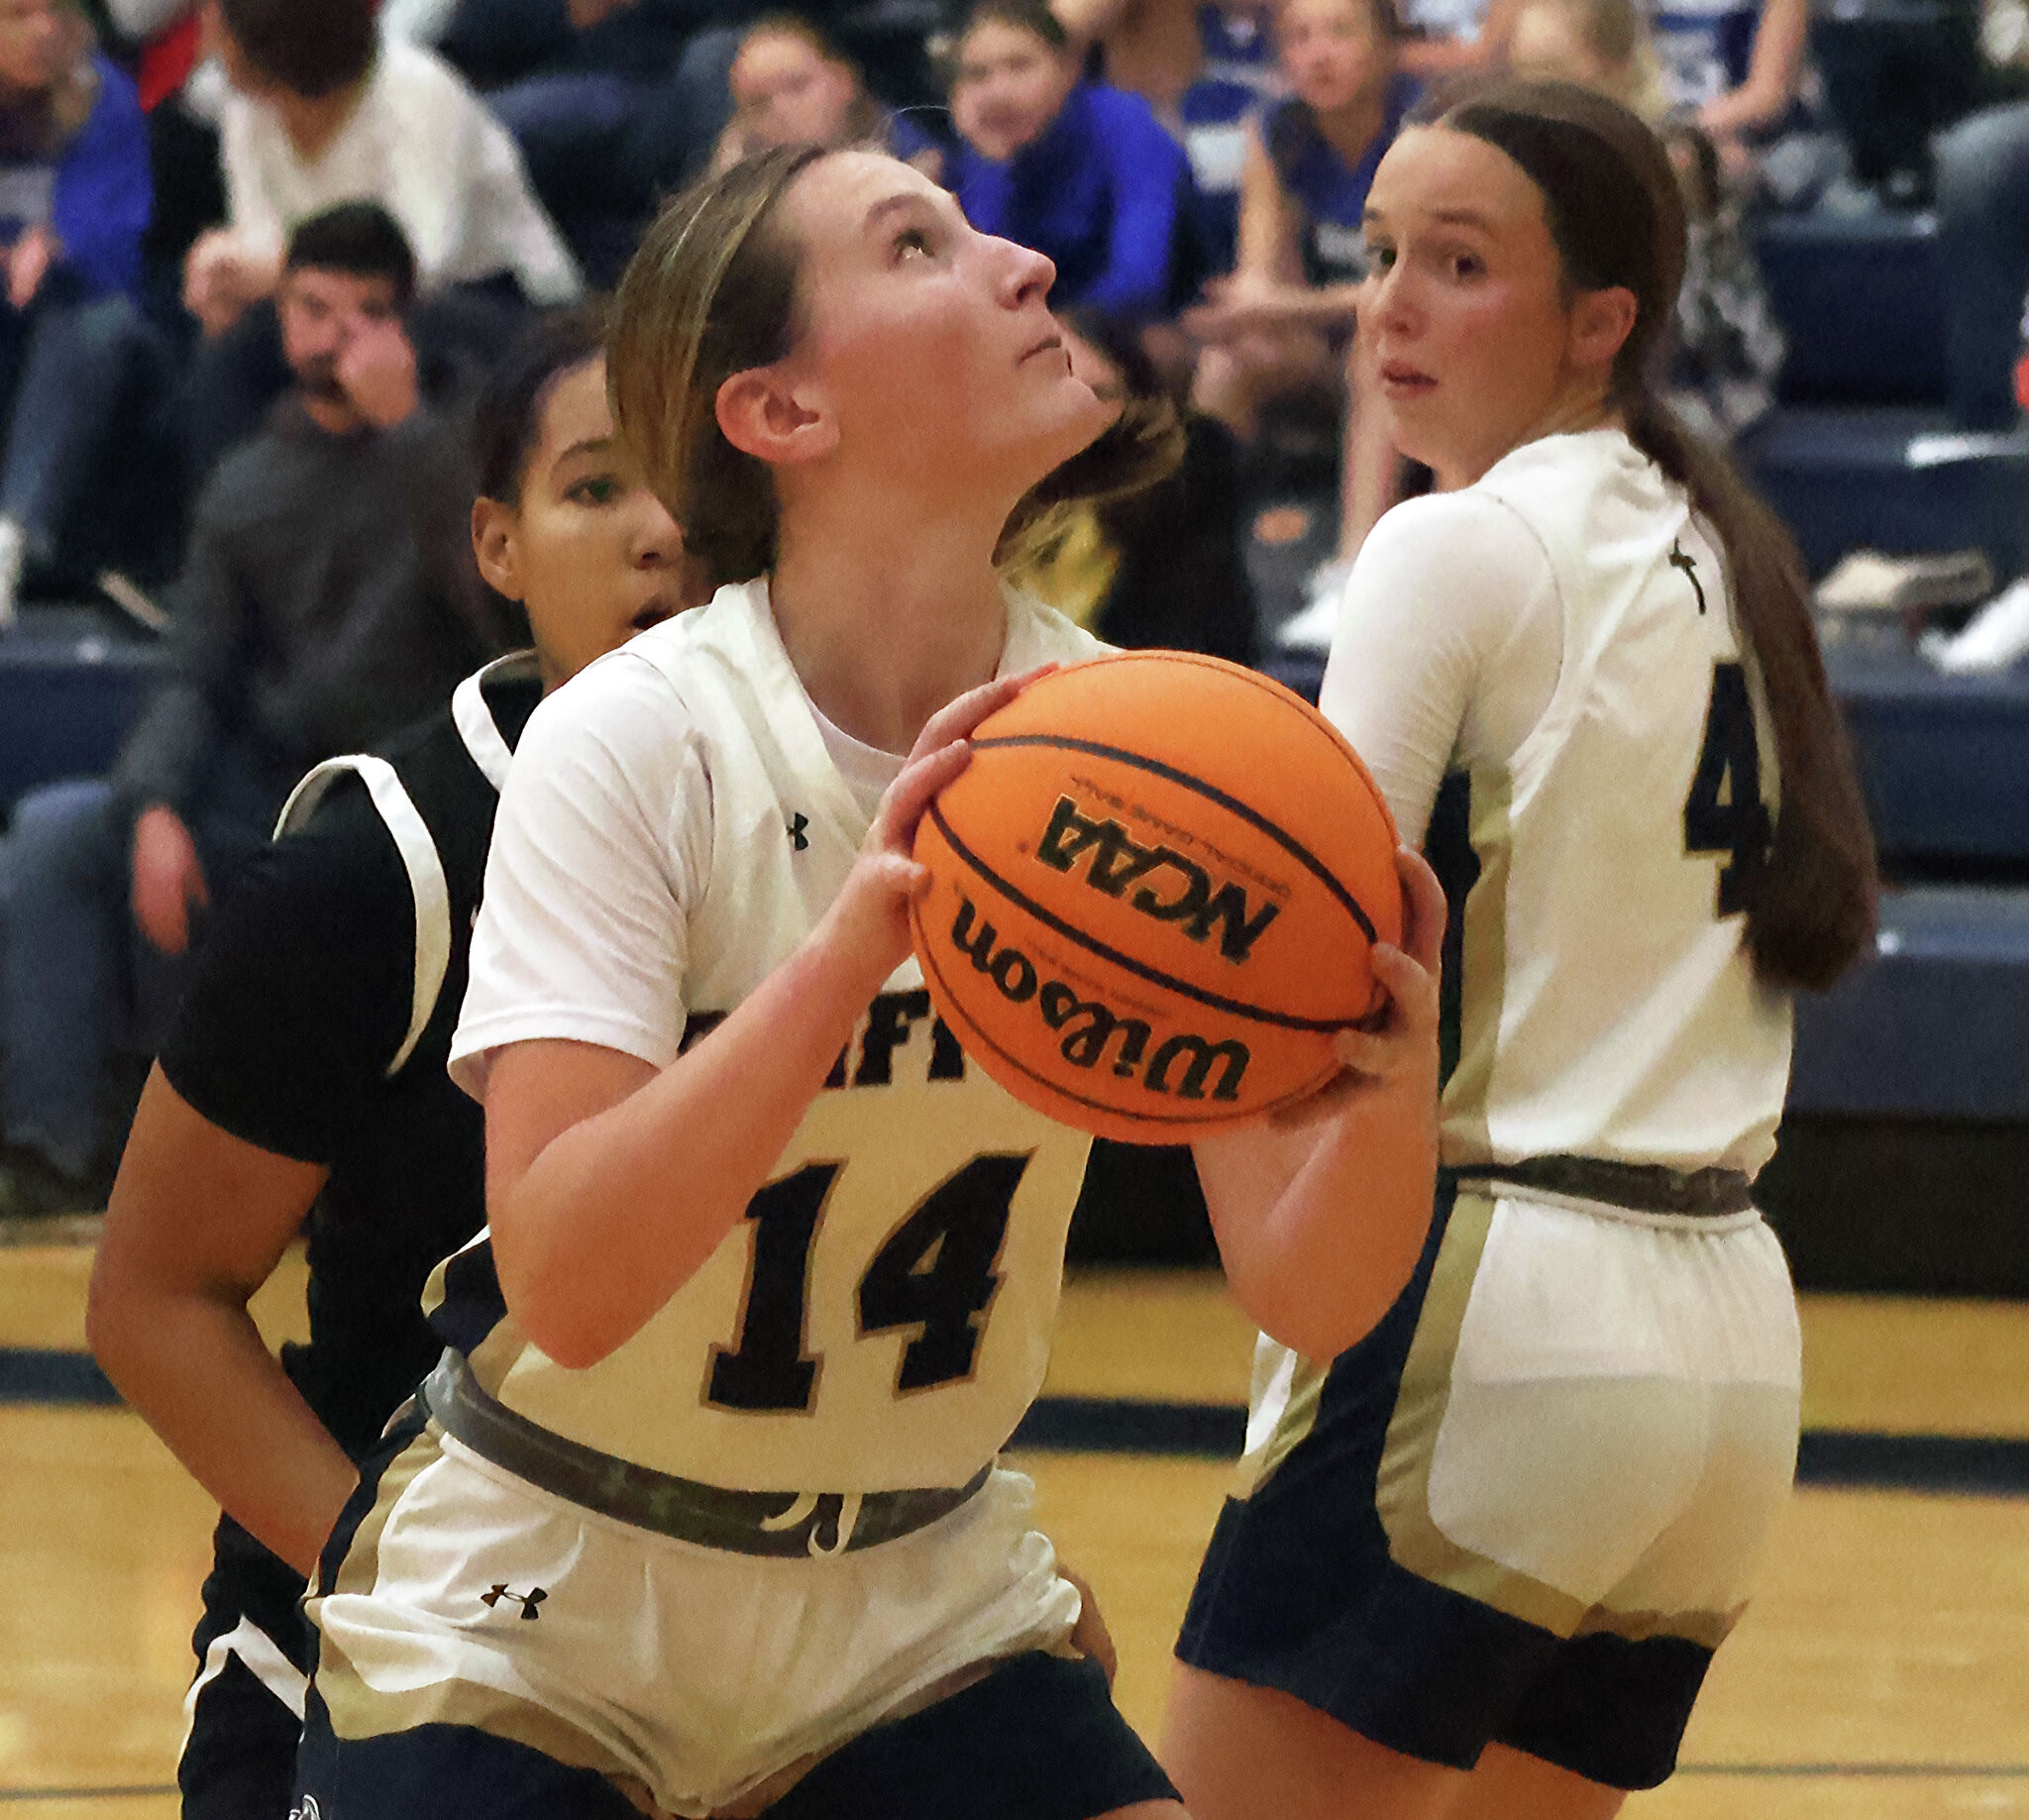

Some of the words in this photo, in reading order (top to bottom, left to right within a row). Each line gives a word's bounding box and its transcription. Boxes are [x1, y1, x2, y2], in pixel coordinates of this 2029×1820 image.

[1034, 793, 1280, 965] NCAA
[1681, 657, 1773, 919] 4
[950, 880, 1251, 1102] Wilson
[700, 1145, 1038, 1417] 14
